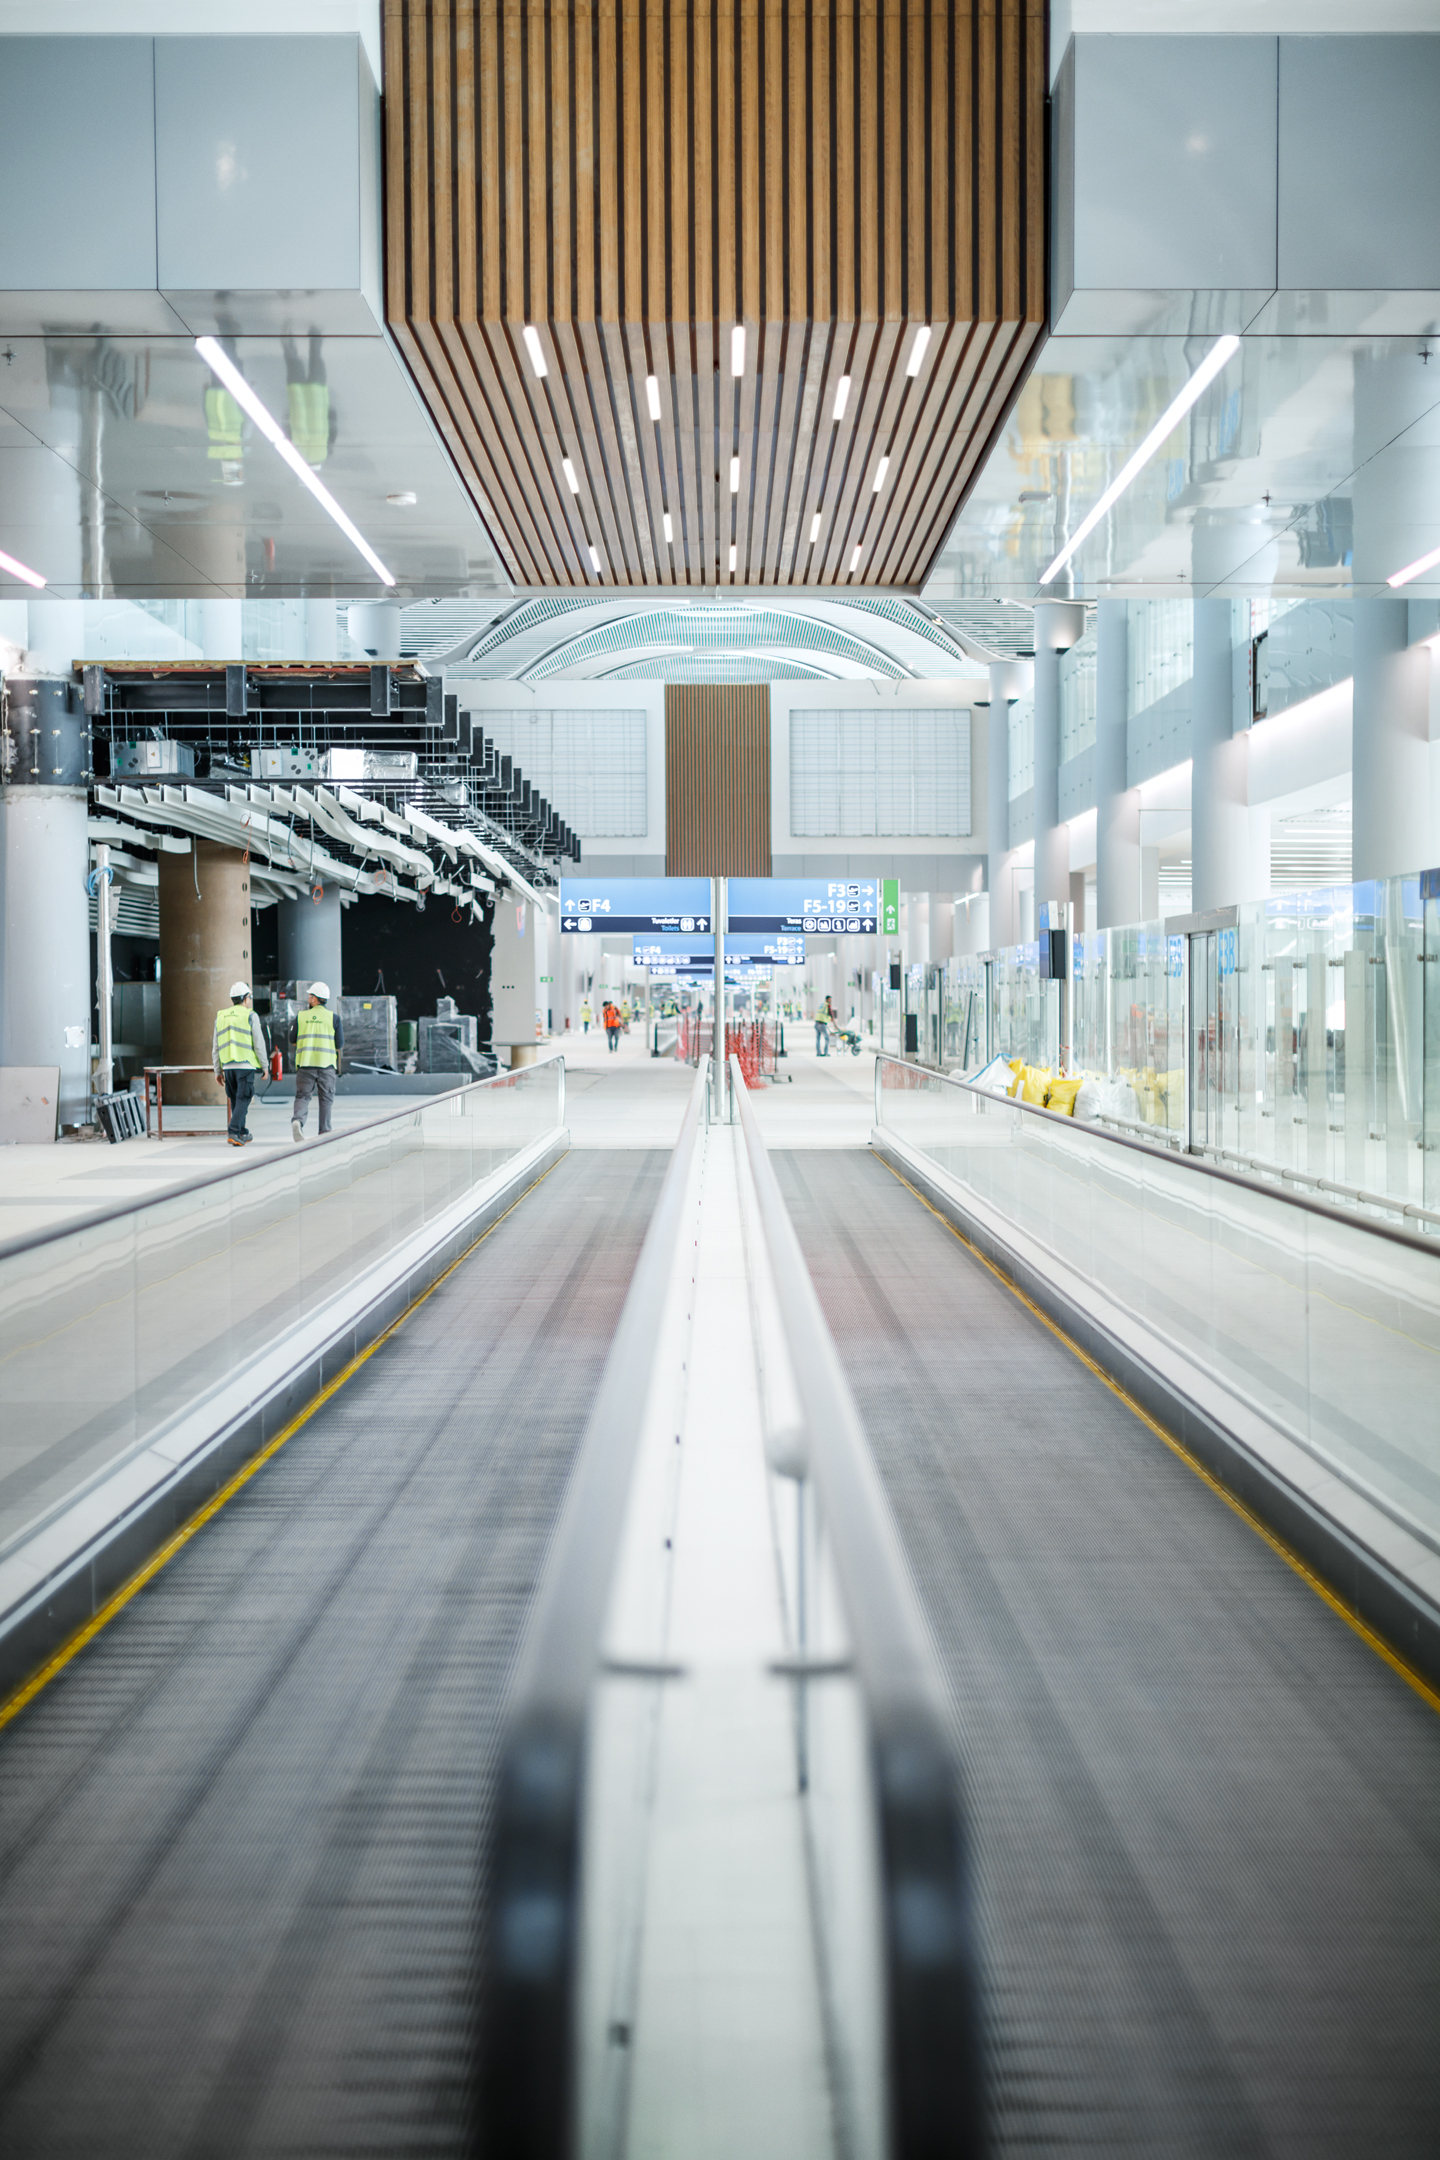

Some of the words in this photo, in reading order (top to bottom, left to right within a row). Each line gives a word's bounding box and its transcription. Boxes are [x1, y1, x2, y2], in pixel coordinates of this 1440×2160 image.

[828, 883, 846, 897] F3
[592, 899, 611, 912] F4
[803, 899, 846, 913] F5-19
[651, 917, 680, 925] Tuvaletler
[786, 917, 802, 925] Teras
[776, 937, 788, 946] F3
[649, 946, 661, 954] F4
[764, 946, 788, 954] F5-19
[1218, 930, 1235, 975] F3B
